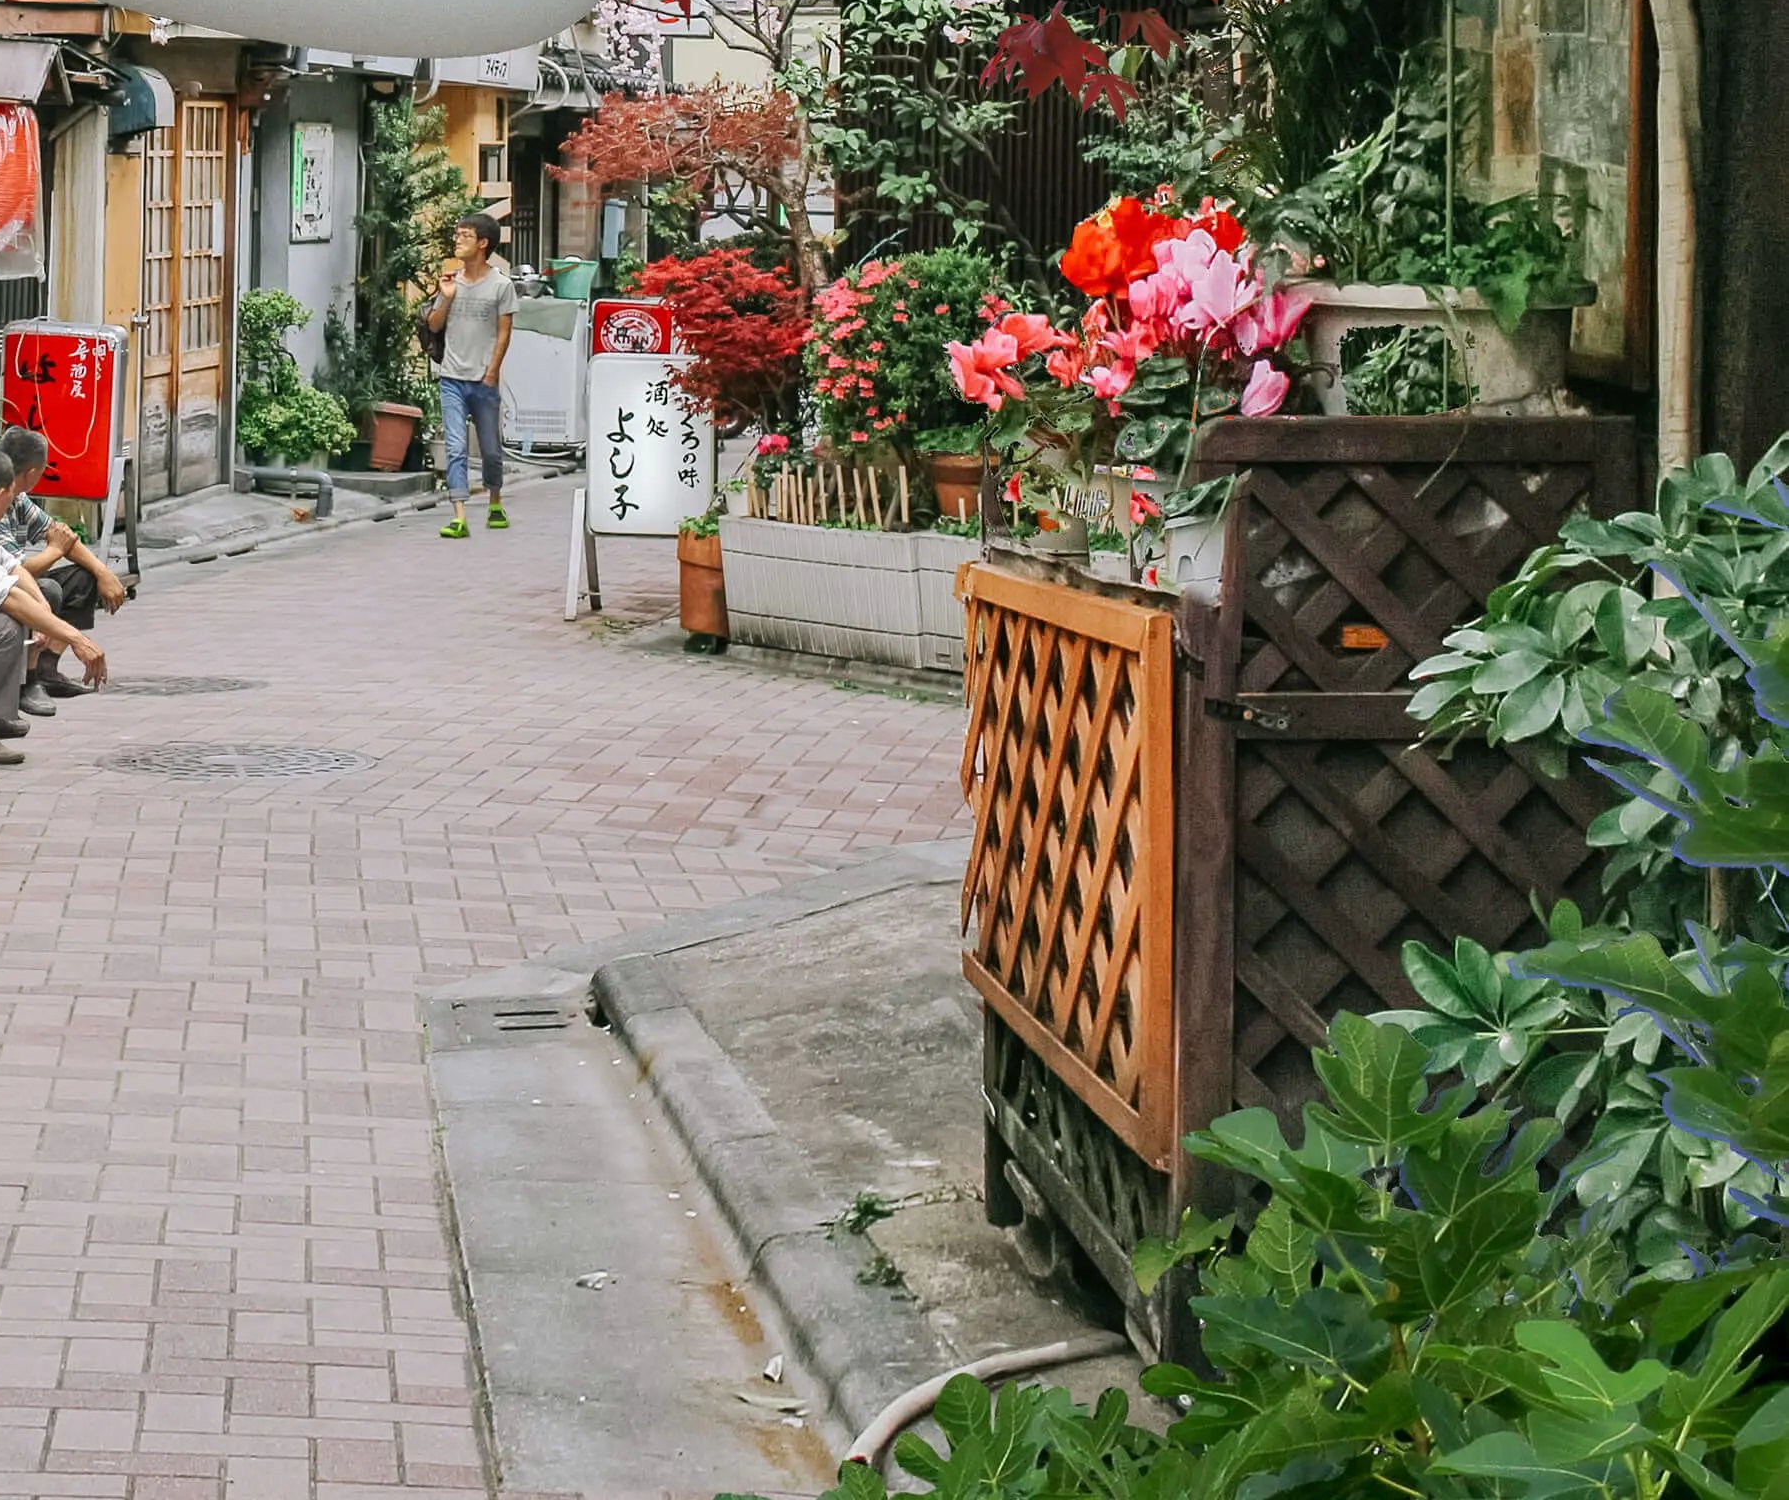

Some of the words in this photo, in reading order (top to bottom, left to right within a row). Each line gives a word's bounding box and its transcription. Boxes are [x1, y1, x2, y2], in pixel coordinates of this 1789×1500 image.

[645, 380, 669, 438] 酒処
[606, 406, 640, 521] よし子
